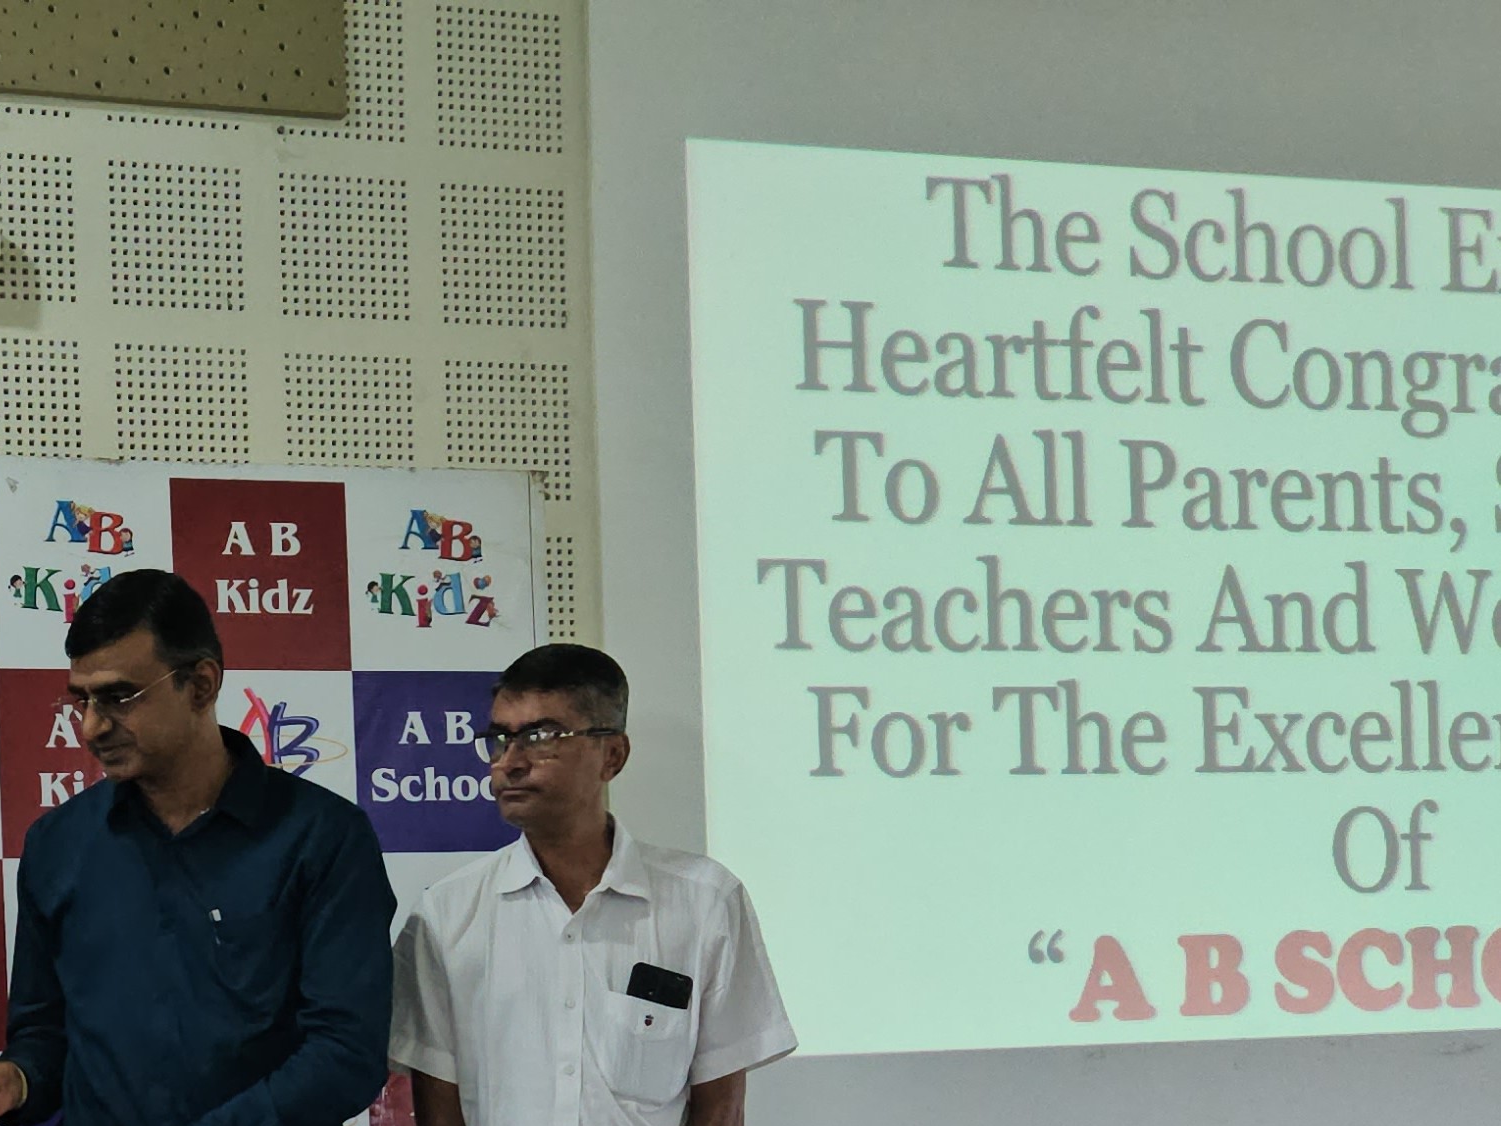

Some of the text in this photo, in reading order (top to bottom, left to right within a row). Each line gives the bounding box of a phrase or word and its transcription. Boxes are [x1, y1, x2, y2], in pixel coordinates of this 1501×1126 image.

[925, 173, 1501, 295] The School E
[794, 298, 1207, 406] Heartfelt
[813, 429, 940, 526] To
[963, 429, 1093, 528] All
[1119, 438, 1468, 553] Parents,
[221, 521, 301, 558] A B
[215, 577, 314, 616] Kidz
[376, 567, 498, 629] Kidz
[756, 554, 1501, 657] Teachers And W
[398, 711, 475, 745] A B
[807, 684, 971, 779] For
[991, 678, 1168, 777] The
[38, 770, 86, 807] Ki
[371, 766, 497, 803] Schoo
[1331, 799, 1439, 895] Of
[1177, 932, 1251, 1018] B
